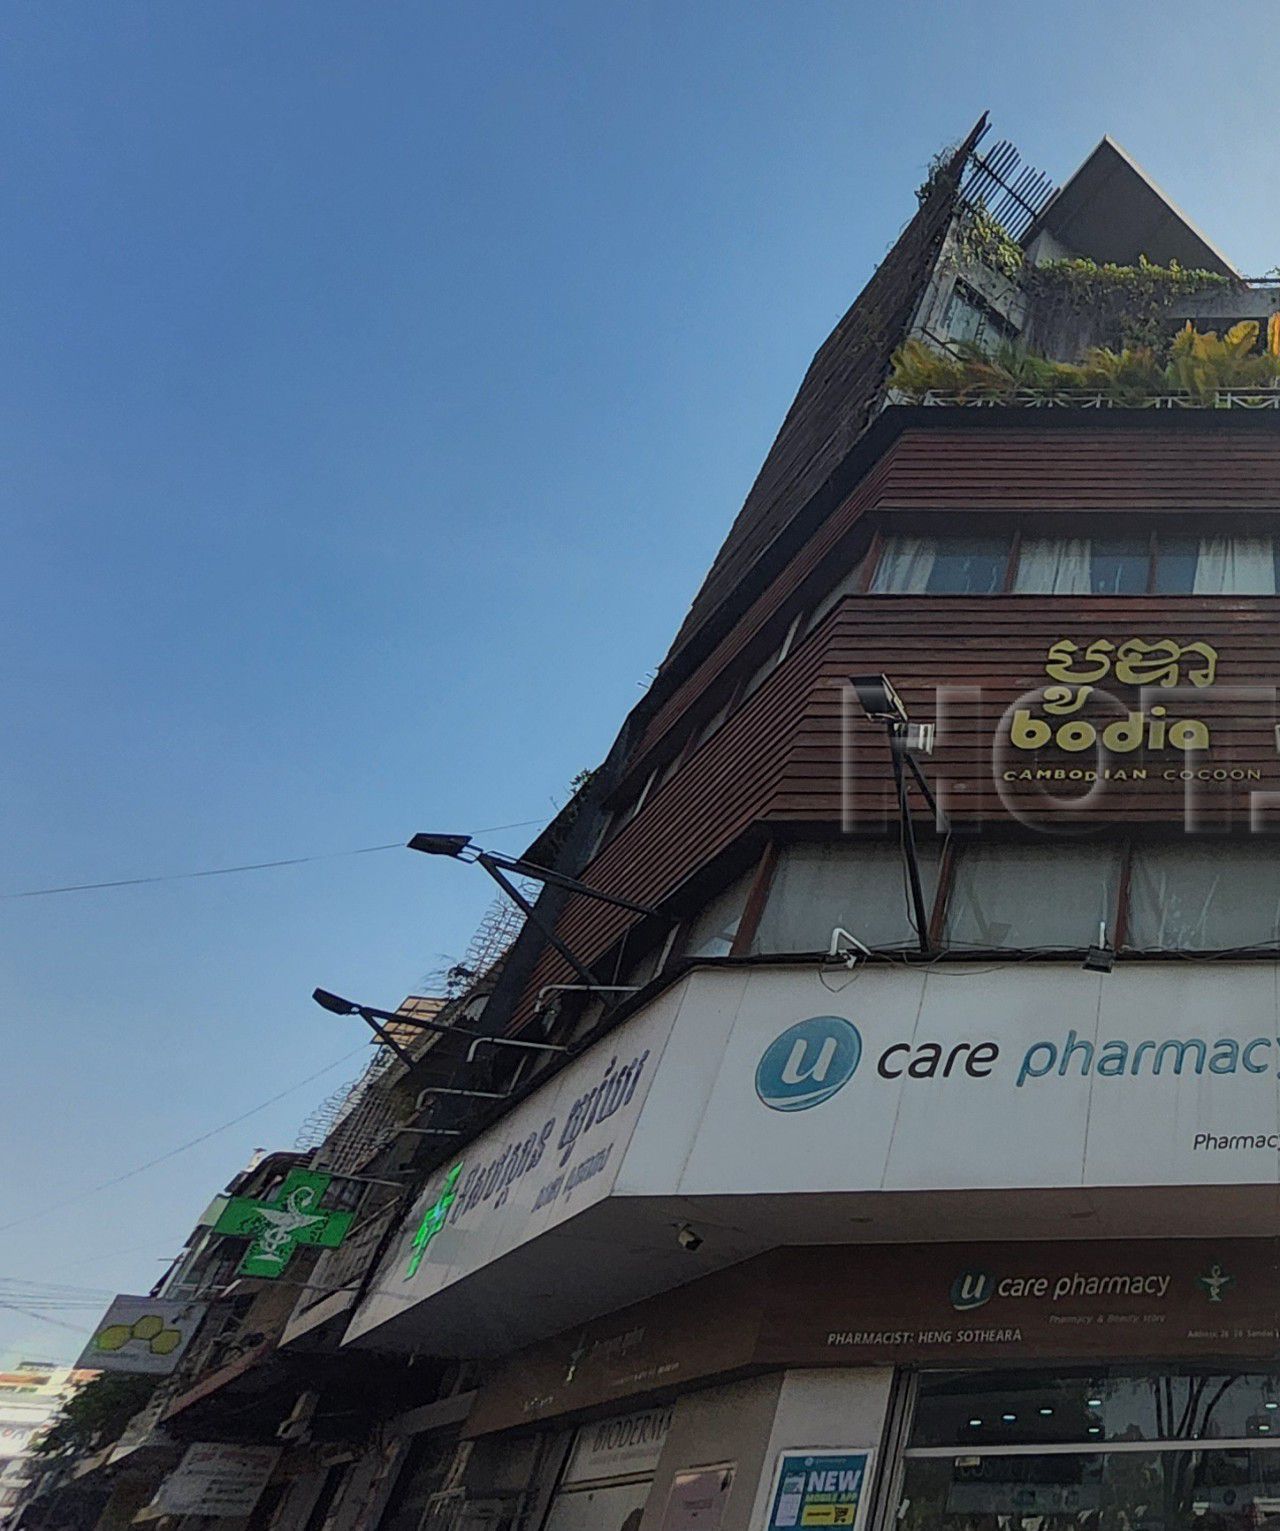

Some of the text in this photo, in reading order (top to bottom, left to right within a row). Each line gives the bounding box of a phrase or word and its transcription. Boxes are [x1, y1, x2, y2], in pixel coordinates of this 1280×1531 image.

[1009, 706, 1210, 754] bodia
[1003, 767, 1262, 782] CAMBODIAN COCOON
[876, 1041, 1000, 1081] care
[997, 1277, 1048, 1297] care
[1052, 1272, 1171, 1301] pharmacy
[826, 1328, 1023, 1346] PHARMACIST: HENG SOTHEARA
[806, 1469, 862, 1492] NEW
